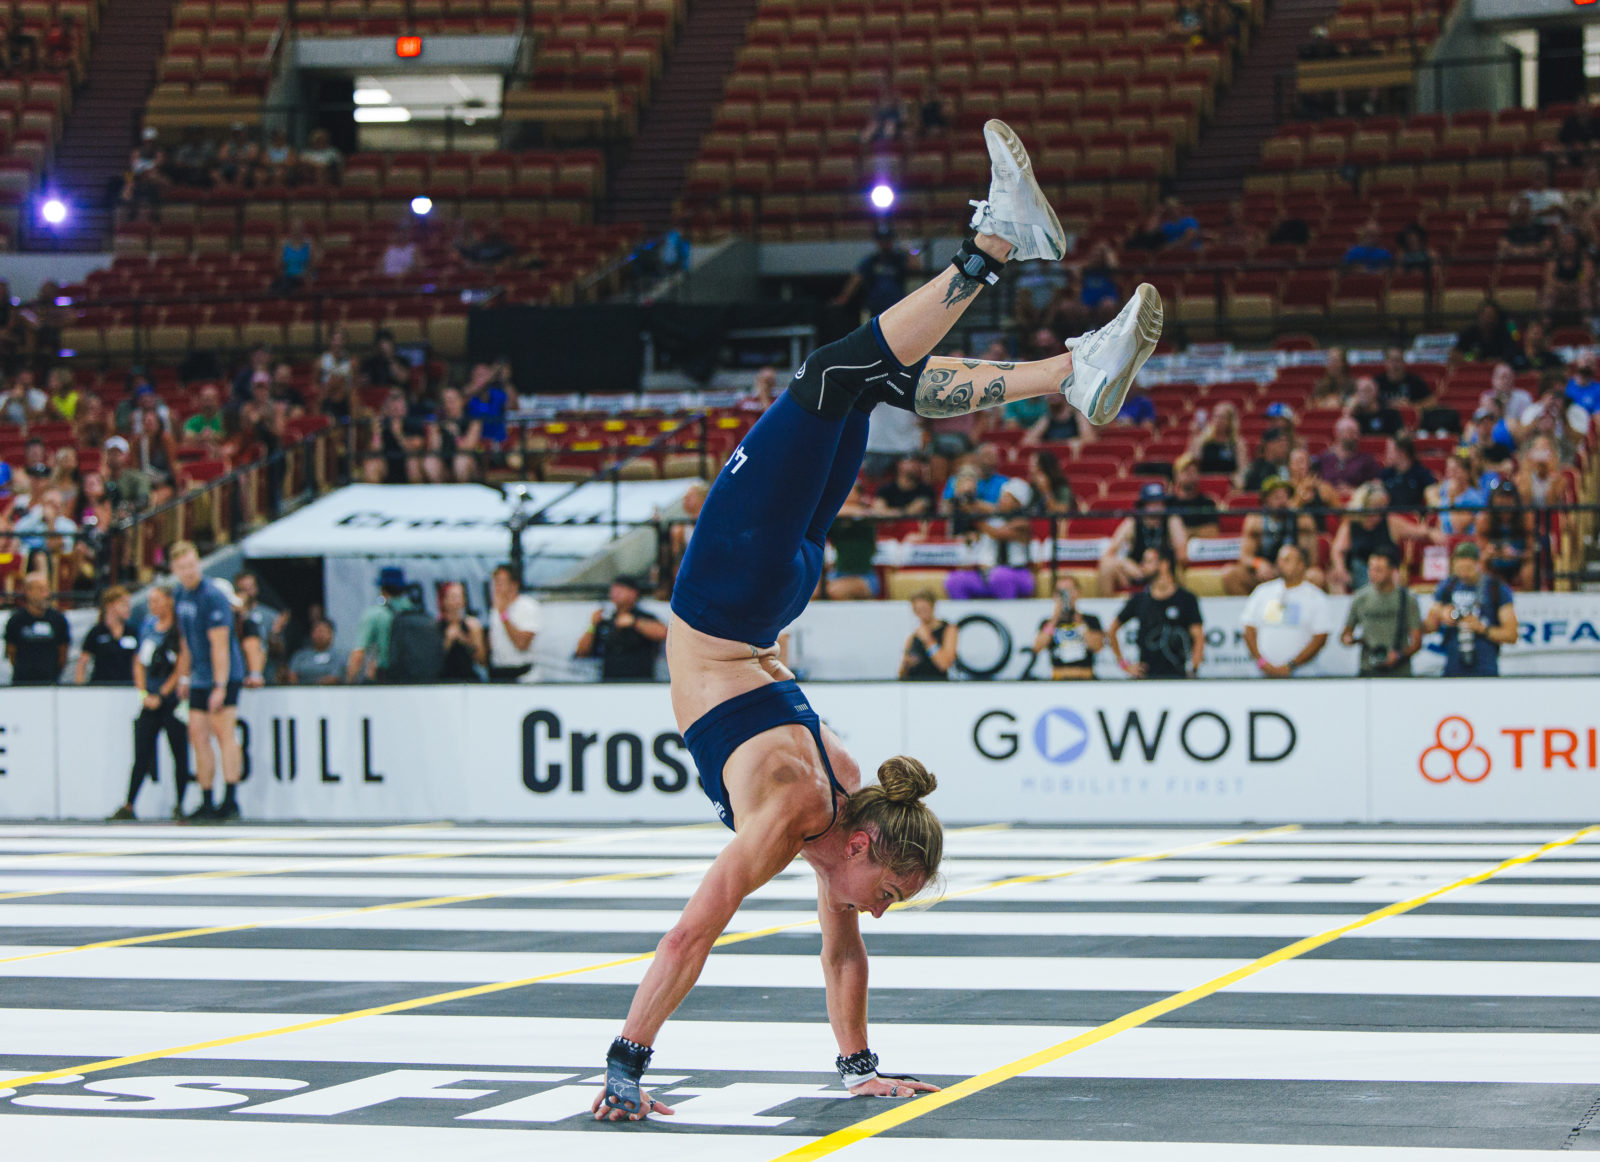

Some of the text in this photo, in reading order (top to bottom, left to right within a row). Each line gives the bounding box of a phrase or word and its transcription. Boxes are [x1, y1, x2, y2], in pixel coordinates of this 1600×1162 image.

[522, 709, 704, 793] Cros
[973, 707, 1297, 764] GOWOD
[1501, 728, 1597, 768] TRI
[1021, 776, 1244, 795] MOBILITY FIRST
